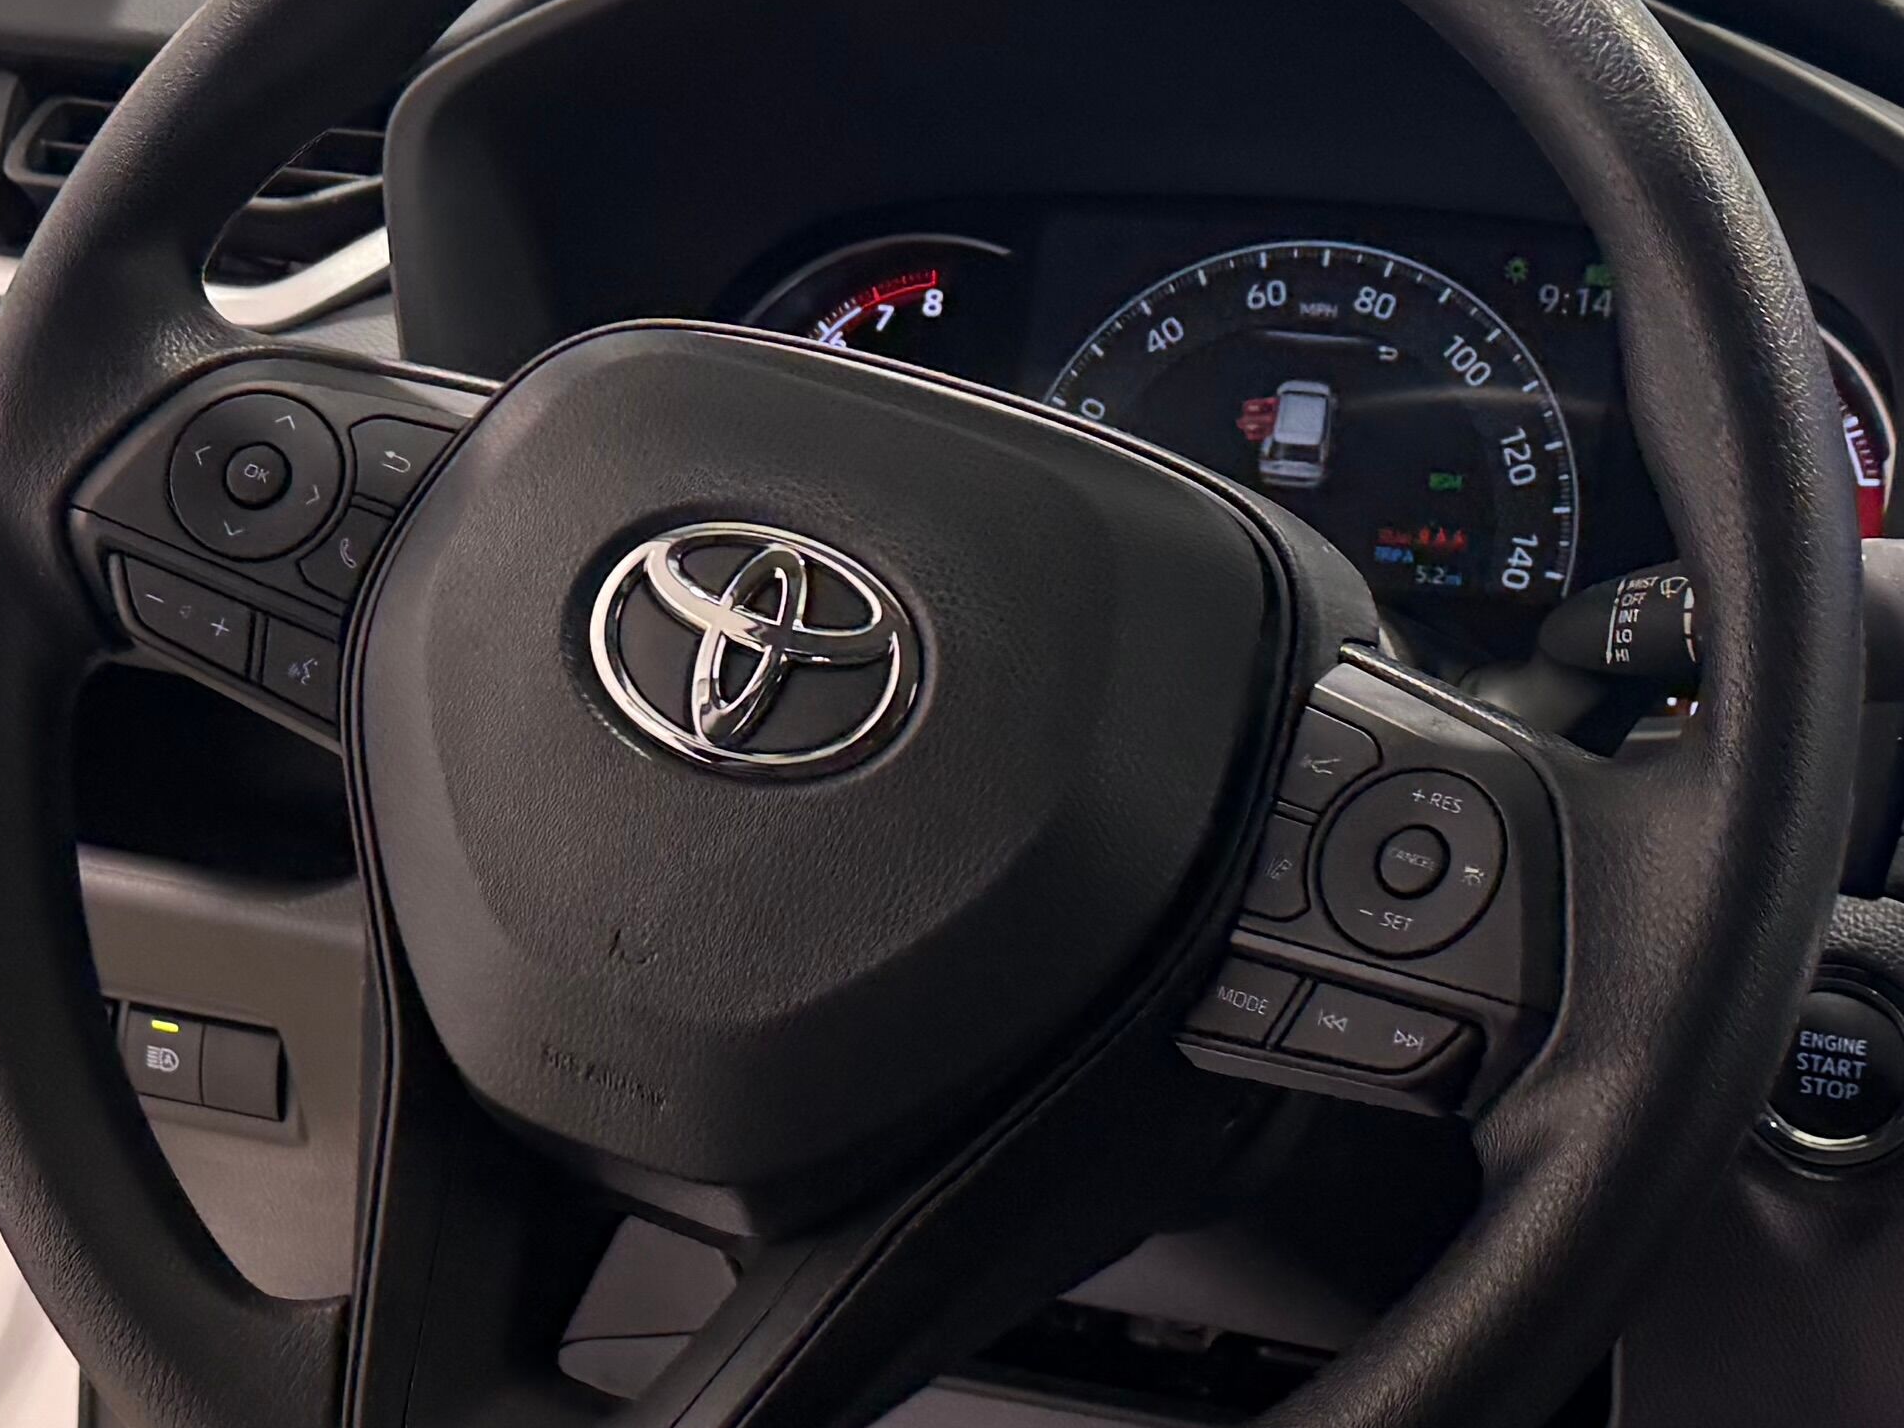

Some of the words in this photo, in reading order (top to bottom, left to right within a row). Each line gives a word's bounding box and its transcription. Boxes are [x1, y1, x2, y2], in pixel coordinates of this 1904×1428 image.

[921, 288, 944, 318] 8
[1246, 279, 1287, 311] 60
[1352, 285, 1397, 321] 80
[876, 305, 895, 332] 7
[1299, 301, 1339, 320] MPH
[1146, 316, 1185, 355] 40
[1442, 333, 1493, 388] 100
[1498, 427, 1537, 488] 120
[1500, 532, 1539, 590] 140
[1621, 591, 1646, 606] OFF
[1618, 608, 1641, 624] INT
[1615, 628, 1633, 644] LO
[1614, 648, 1631, 663] HI
[1429, 791, 1465, 815] RES
[1378, 911, 1415, 932] SET
[1216, 985, 1270, 1016] MODE
[1799, 1030, 1869, 1057] ENGINE
[1796, 1052, 1867, 1080] START
[1800, 1075, 1861, 1100] STOP
